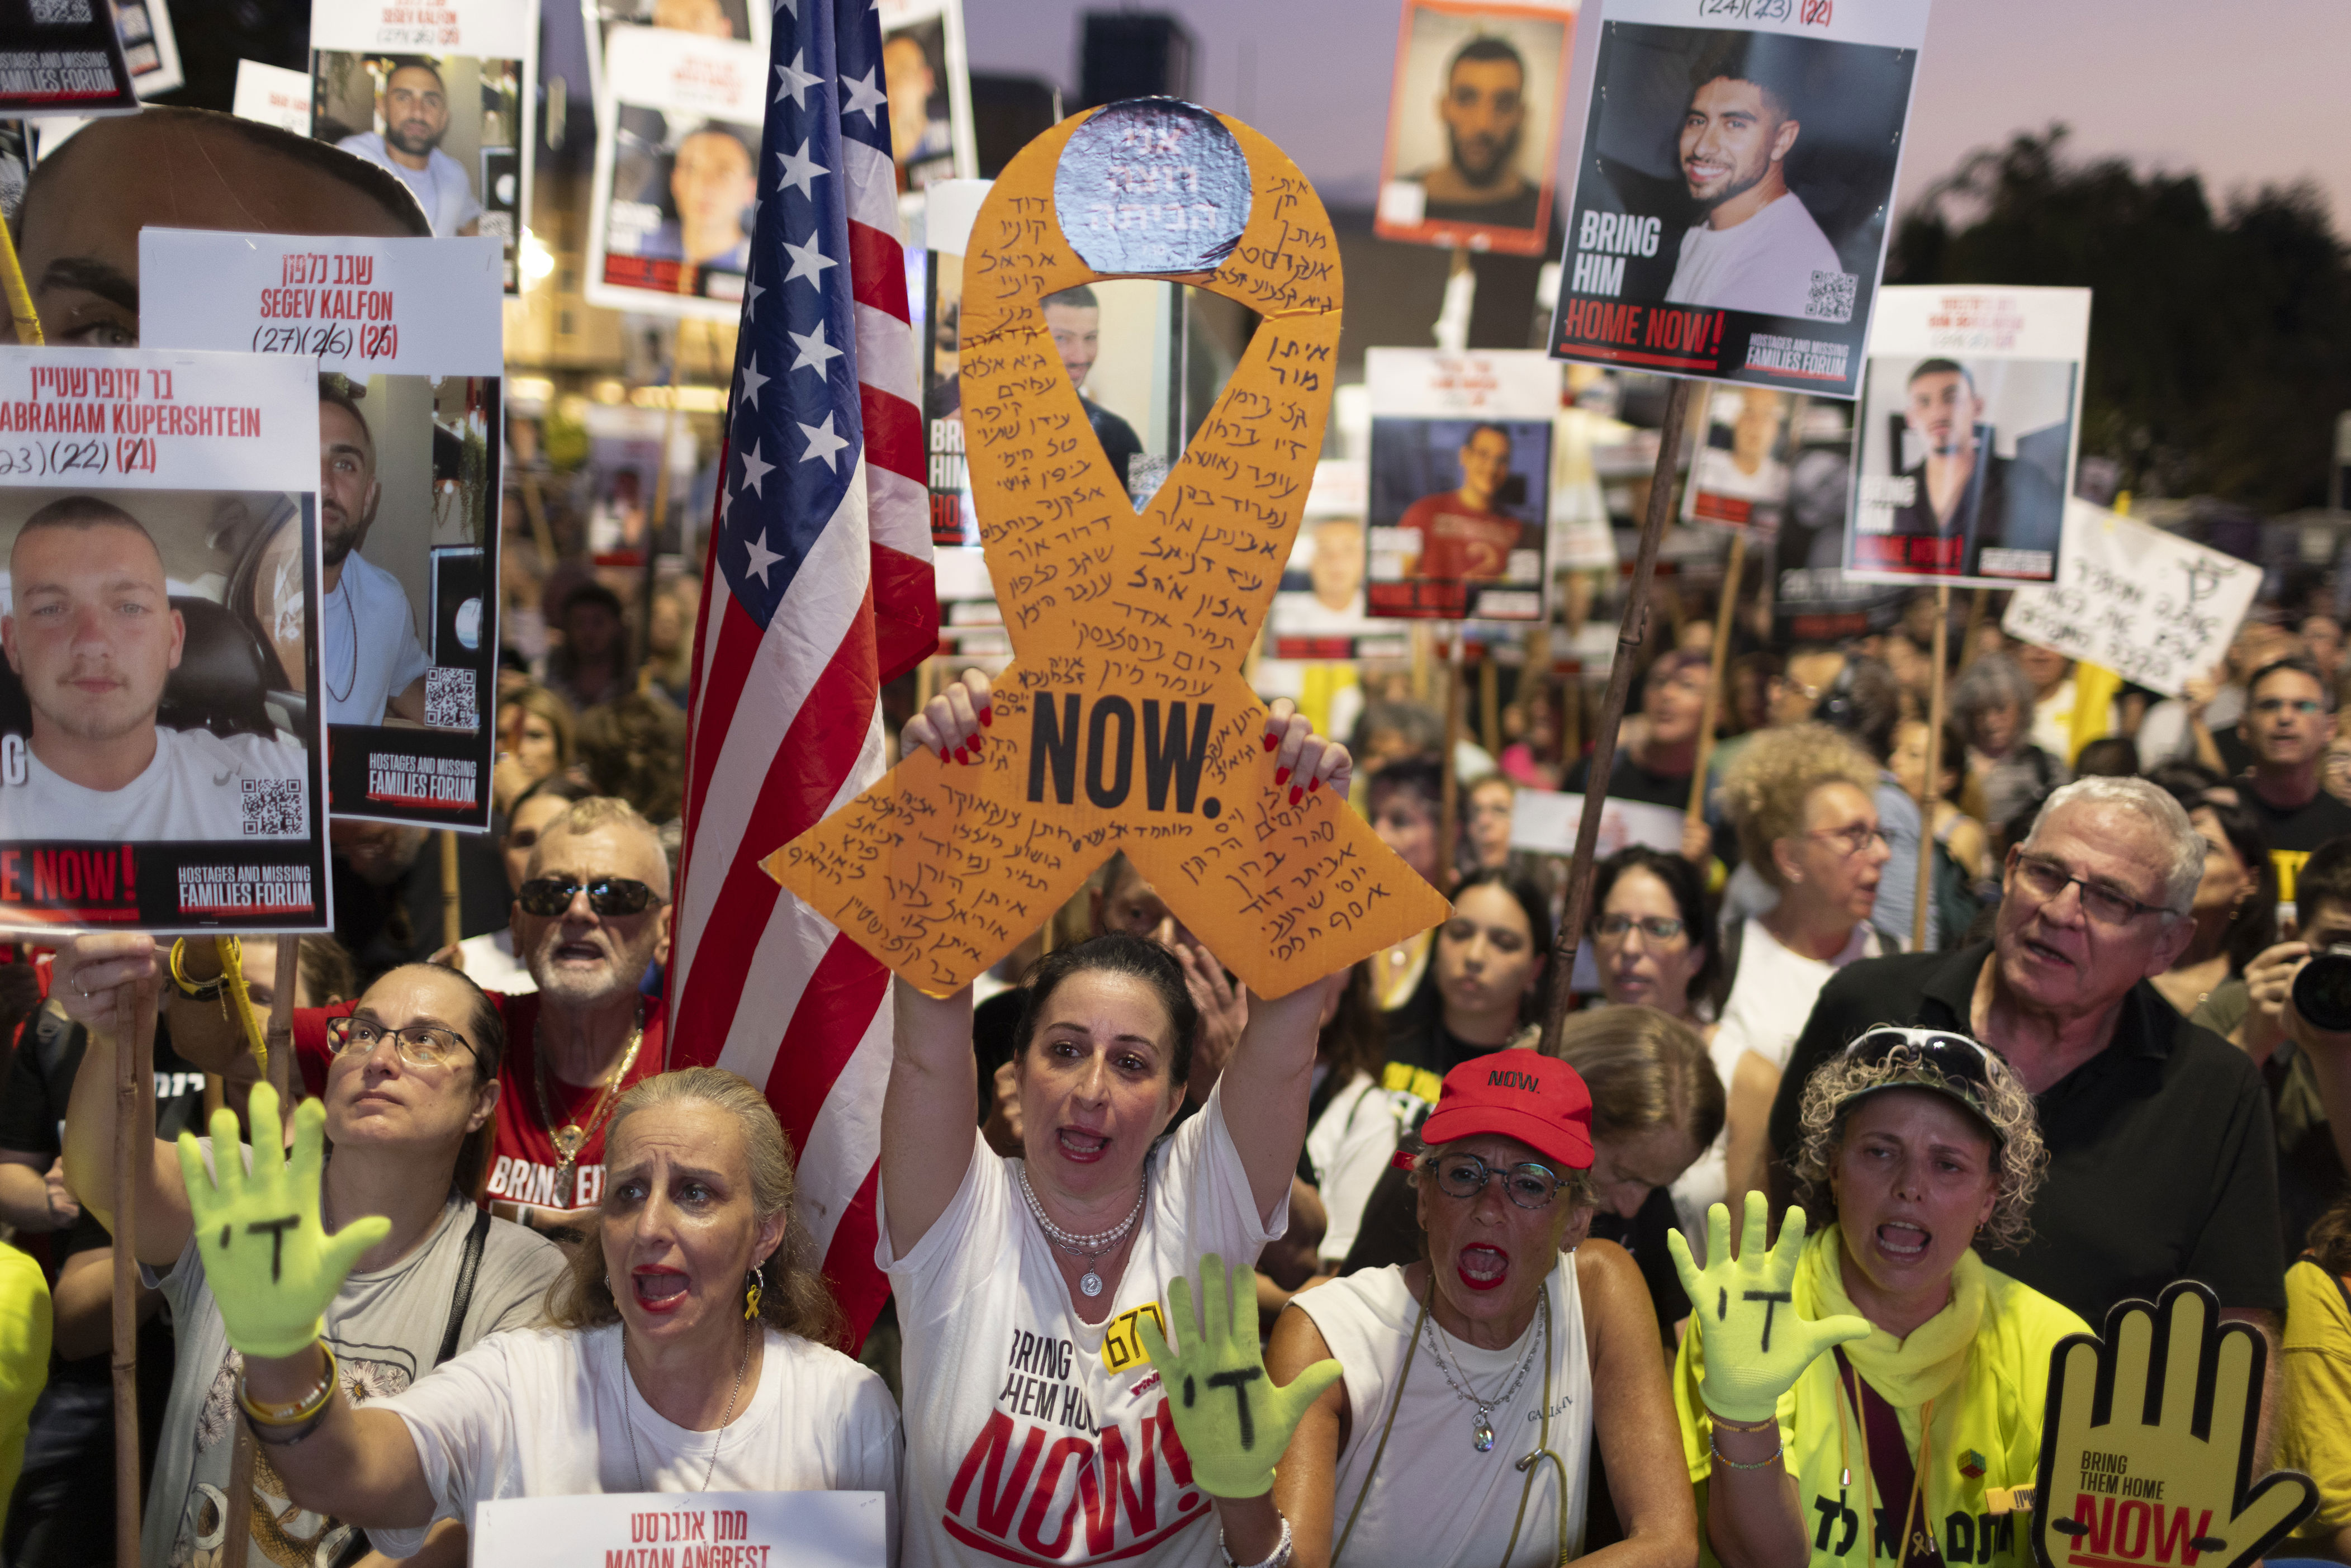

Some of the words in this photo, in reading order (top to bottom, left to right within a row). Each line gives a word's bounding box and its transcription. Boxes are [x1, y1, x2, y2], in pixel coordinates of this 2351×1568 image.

[61, 51, 108, 68] MISSING
[60, 68, 116, 92] FORUM
[1008, 196, 1048, 214] דוד
[1091, 203, 1216, 230] הביתה
[1578, 209, 1662, 258] BRING
[282, 252, 328, 287] כלפון
[333, 254, 373, 286] שגב
[977, 249, 1057, 274] אריאל
[1571, 252, 1626, 297] HIM
[260, 288, 316, 318] SEGEV
[320, 289, 394, 321] KALFON
[1566, 298, 1643, 345] HOME
[1644, 307, 1727, 356] NOW!
[1267, 336, 1331, 362] איתן
[1750, 332, 1793, 351] HOSTAGES
[1793, 337, 1810, 353] AND
[1810, 340, 1850, 358] MISSING
[1746, 346, 1800, 372] FAMILIES
[1802, 352, 1847, 377] FORUM
[30, 366, 140, 403] קופרשטיין
[146, 368, 174, 400] בר
[998, 376, 1057, 400] עמירם
[1269, 366, 1319, 392] מור
[0, 401, 105, 434] ABRAHAM
[113, 404, 261, 437] KUPERSHTEIN
[930, 419, 966, 453] BRI
[1046, 437, 1078, 458] טל
[1055, 515, 1113, 544] דרור
[1112, 600, 1173, 629] אדר
[1182, 622, 1234, 651] תמיר
[1097, 659, 1144, 692] מירן
[1173, 650, 1221, 675] רום
[369, 752, 416, 773] HOSTAGES
[417, 757, 436, 774] AND
[437, 757, 477, 778] MISSING
[1027, 690, 1222, 820] NOW.
[369, 770, 427, 798] FAMILIES
[429, 775, 476, 803] FORUM
[1134, 822, 1193, 840] מוחמד
[33, 845, 138, 902] NOW!
[178, 866, 235, 883] HOSTAGES
[237, 866, 260, 883] AND
[262, 866, 311, 883] MISSING
[179, 883, 252, 907] FAMILIES
[255, 883, 312, 906] FORUM
[1239, 885, 1284, 913] דוד
[1487, 1070, 1541, 1094] NOW.
[999, 1372, 1059, 1422] HEM
[2080, 1450, 2128, 1475] BRING
[2080, 1470, 2119, 1494] THEM
[2122, 1476, 2165, 1501] HOME
[631, 1510, 705, 1543] אנגרסט
[713, 1510, 748, 1543] מתן
[2070, 1493, 2214, 1567] NOW
[605, 1547, 675, 1568] MATAN
[681, 1545, 771, 1568] ANGREST
